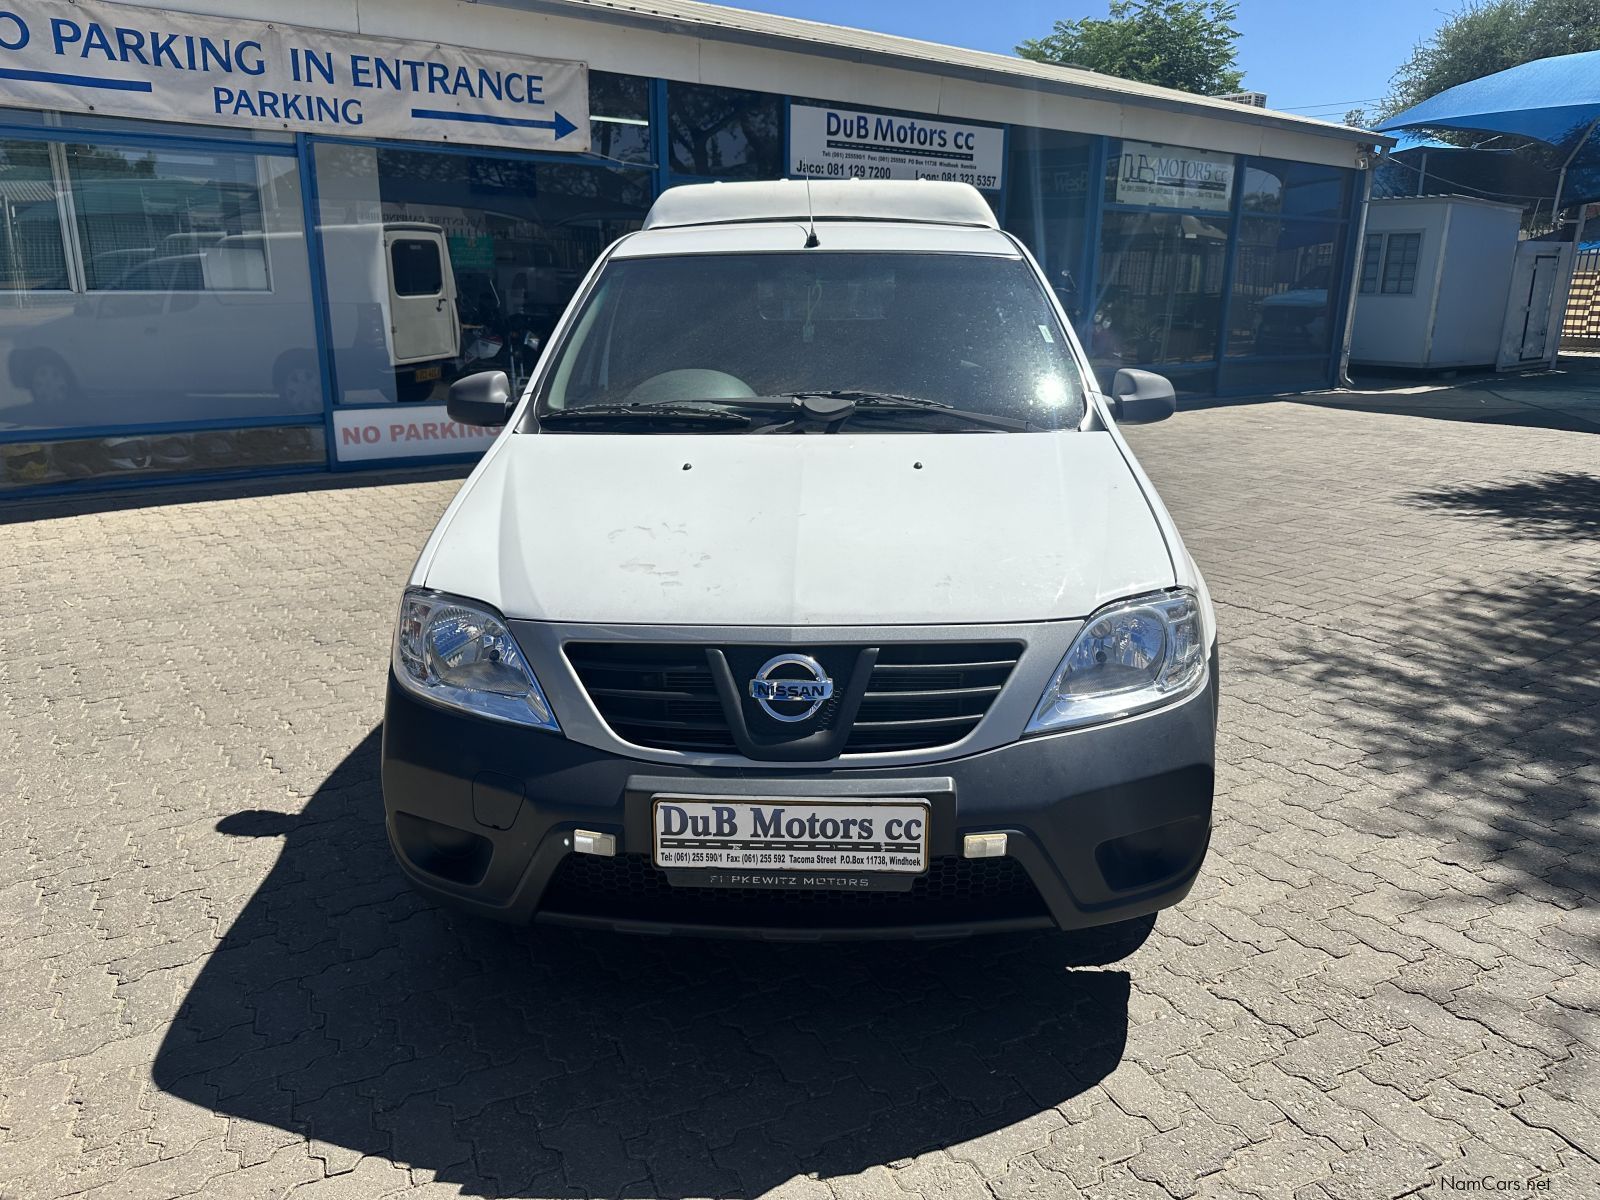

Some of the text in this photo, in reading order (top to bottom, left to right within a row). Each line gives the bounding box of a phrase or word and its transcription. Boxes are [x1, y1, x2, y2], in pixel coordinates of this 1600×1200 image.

[0, 11, 546, 105] O PARKING IN ENTRANCE
[213, 86, 364, 125] PARKING
[826, 111, 975, 151] DuB Motors cc
[796, 160, 824, 174] Jaco:
[827, 162, 844, 176] 081
[848, 164, 866, 178] 129
[868, 166, 891, 180] 7200
[941, 172, 957, 183] 081
[959, 173, 974, 186] 323
[977, 176, 997, 187] 5357
[1157, 158, 1212, 181] MOTORS
[342, 422, 503, 446] NO PARKING
[757, 684, 825, 697] NISSAN
[660, 804, 922, 841] DuB Motors cc
[661, 852, 673, 862] Tel:
[674, 852, 691, 864] (061)
[692, 853, 704, 862] 255
[726, 853, 740, 863] Fax:
[741, 854, 758, 865] (061)
[760, 854, 772, 863] 255
[774, 854, 786, 863] 592
[789, 854, 815, 864] Tacoma
[817, 854, 837, 864] Street
[866, 856, 888, 866] 11738,
[889, 856, 921, 867] Windhoek
[803, 876, 870, 887] MOTORS
